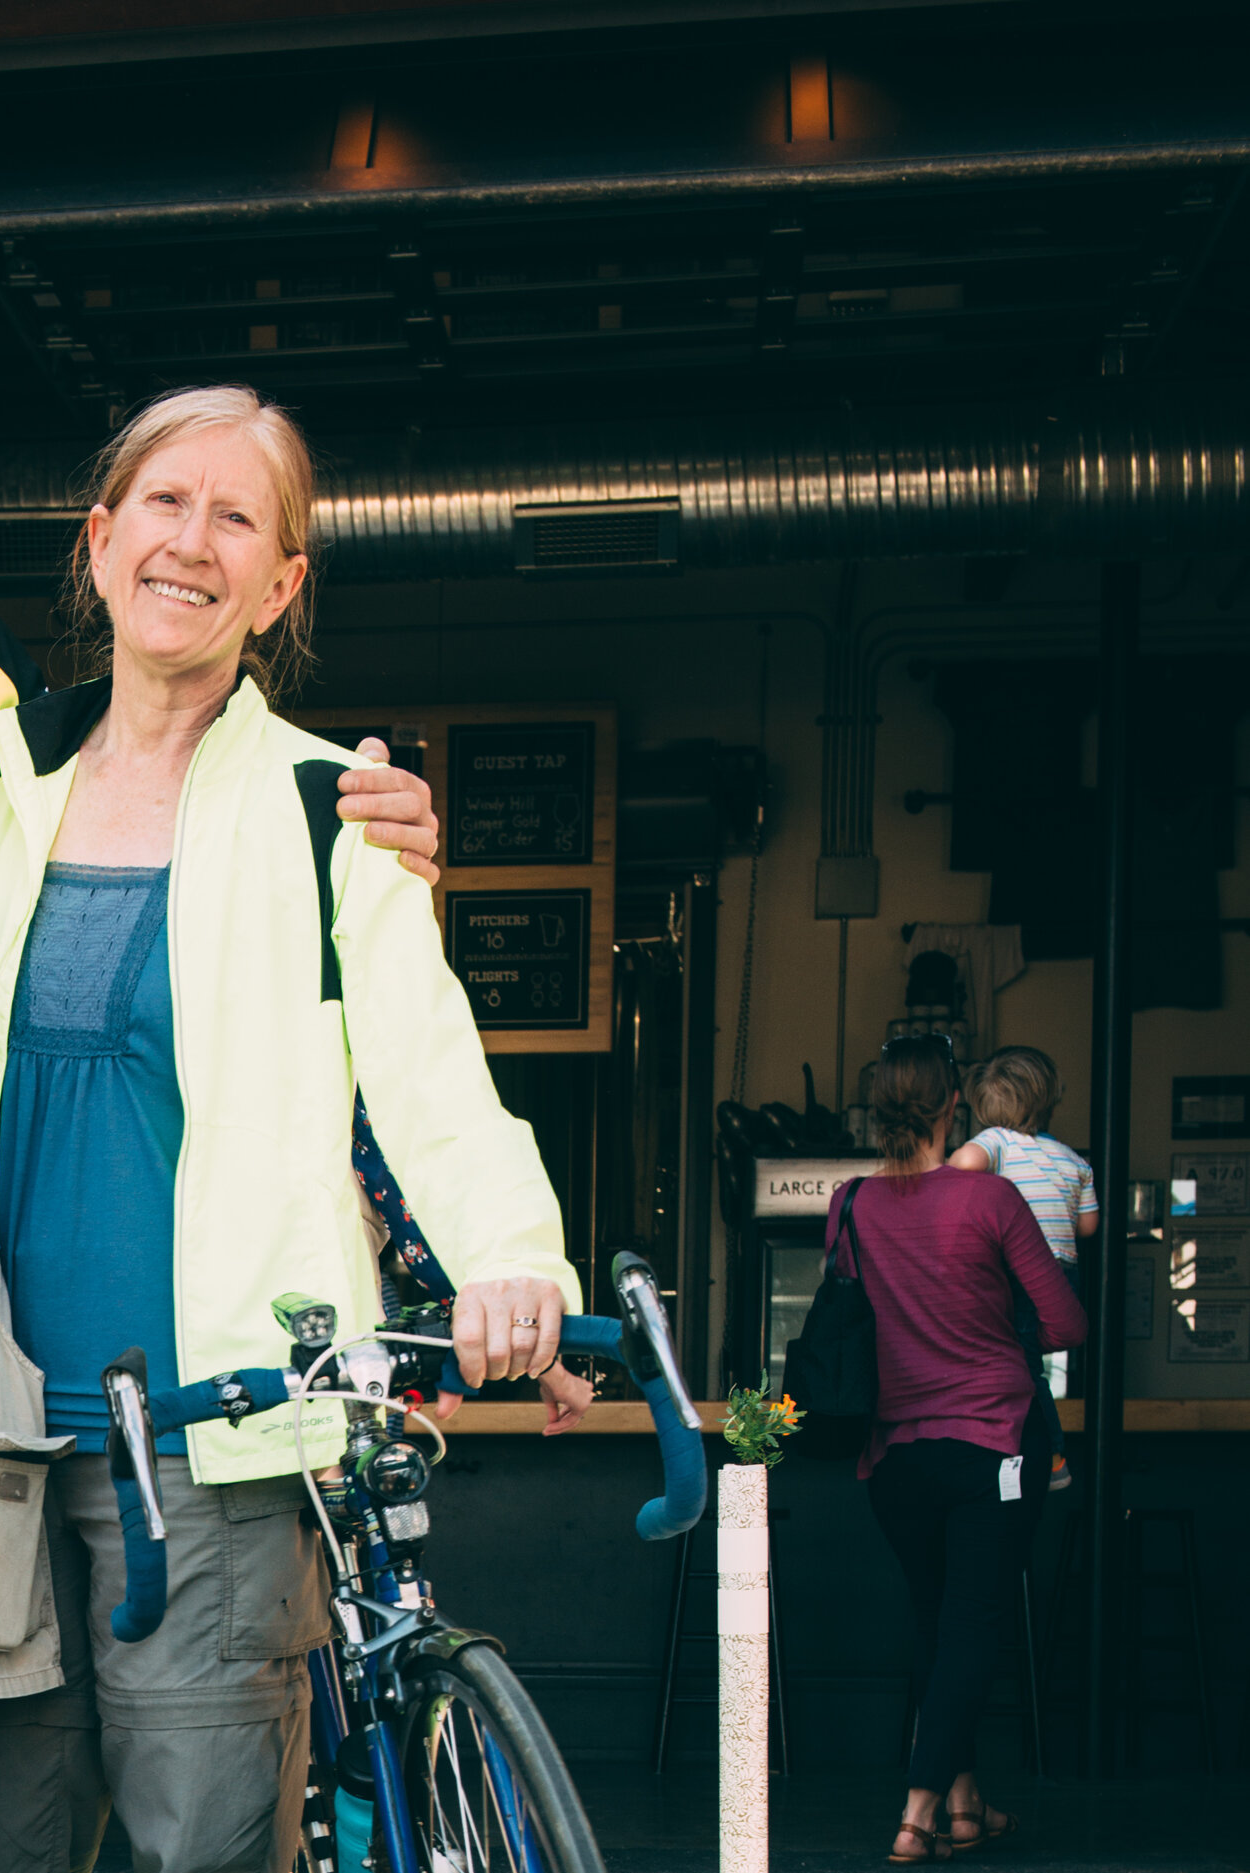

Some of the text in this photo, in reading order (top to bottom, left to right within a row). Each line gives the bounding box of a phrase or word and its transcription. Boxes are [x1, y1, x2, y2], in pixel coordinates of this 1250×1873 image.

[473, 753, 567, 771] GUEST TAP
[510, 794, 535, 811] Hill
[511, 813, 541, 829] Gold
[469, 915, 530, 927] PITCHERS
[468, 970, 520, 983] FLIGHTS
[770, 1181, 825, 1196] LARGE
